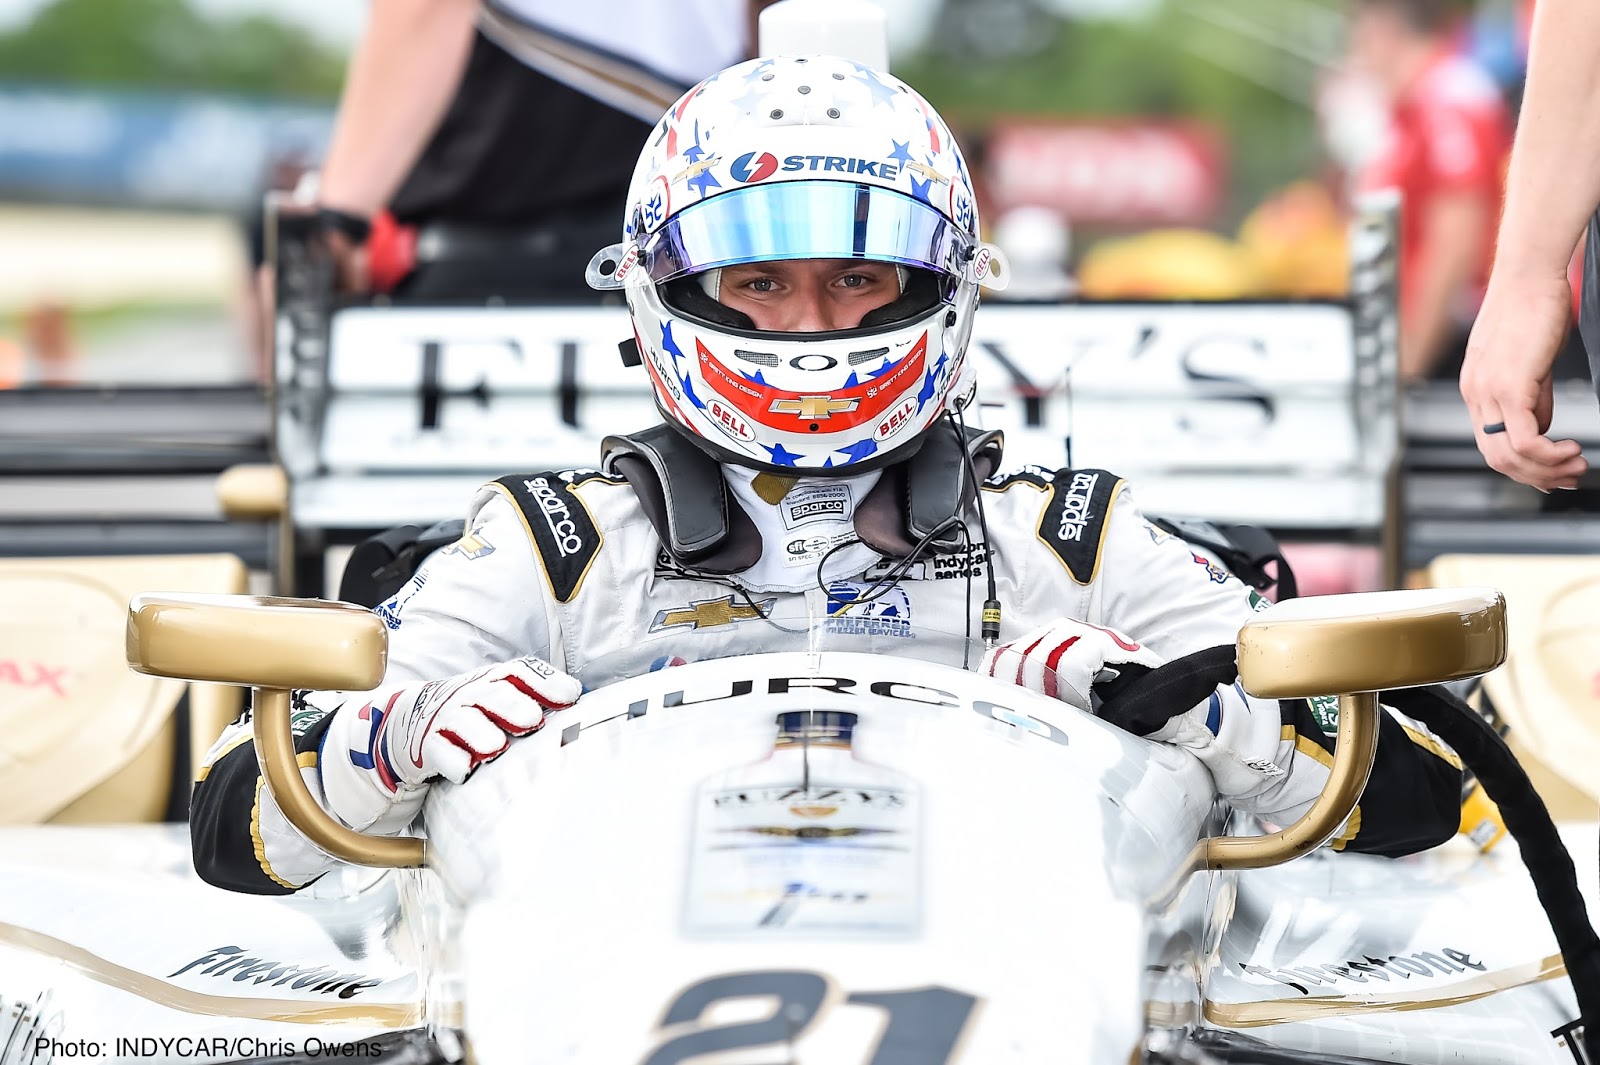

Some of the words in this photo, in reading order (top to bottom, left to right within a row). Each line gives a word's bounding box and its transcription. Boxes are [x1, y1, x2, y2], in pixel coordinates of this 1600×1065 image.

[781, 155, 898, 181] STRIKE
[616, 250, 639, 279] BELL
[975, 252, 990, 276] BELL
[708, 361, 726, 378] BRETT
[725, 376, 739, 389] KING
[879, 374, 898, 391] BRETT
[897, 364, 909, 377] KING
[907, 347, 924, 367] DESIGN
[712, 403, 748, 438] BELL
[879, 403, 913, 437] BELL
[523, 477, 582, 558] sparco
[792, 502, 842, 516] sparco
[1057, 473, 1099, 542] sparco
[560, 675, 1071, 748] HURCO
[166, 944, 390, 999] Firestone
[1238, 946, 1488, 996] Firestone
[637, 967, 988, 1065] 21
